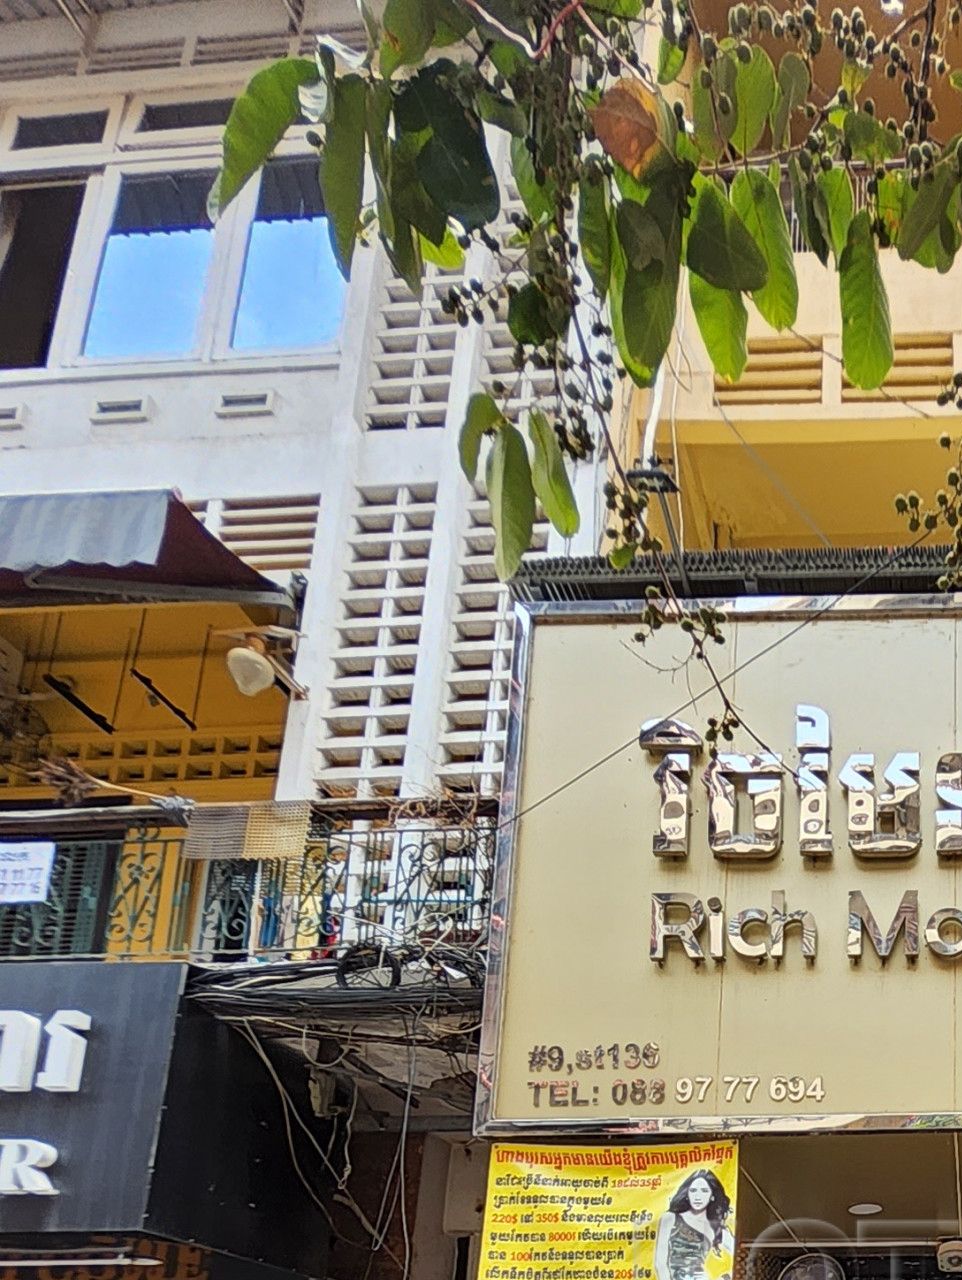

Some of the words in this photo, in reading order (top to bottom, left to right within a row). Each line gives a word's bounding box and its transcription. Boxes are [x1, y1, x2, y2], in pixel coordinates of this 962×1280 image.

[649, 889, 818, 962] Rich
[527, 1079, 599, 1107] TEL:
[674, 1076, 712, 1103] 97
[723, 1076, 760, 1103] 77
[769, 1076, 825, 1103] 694
